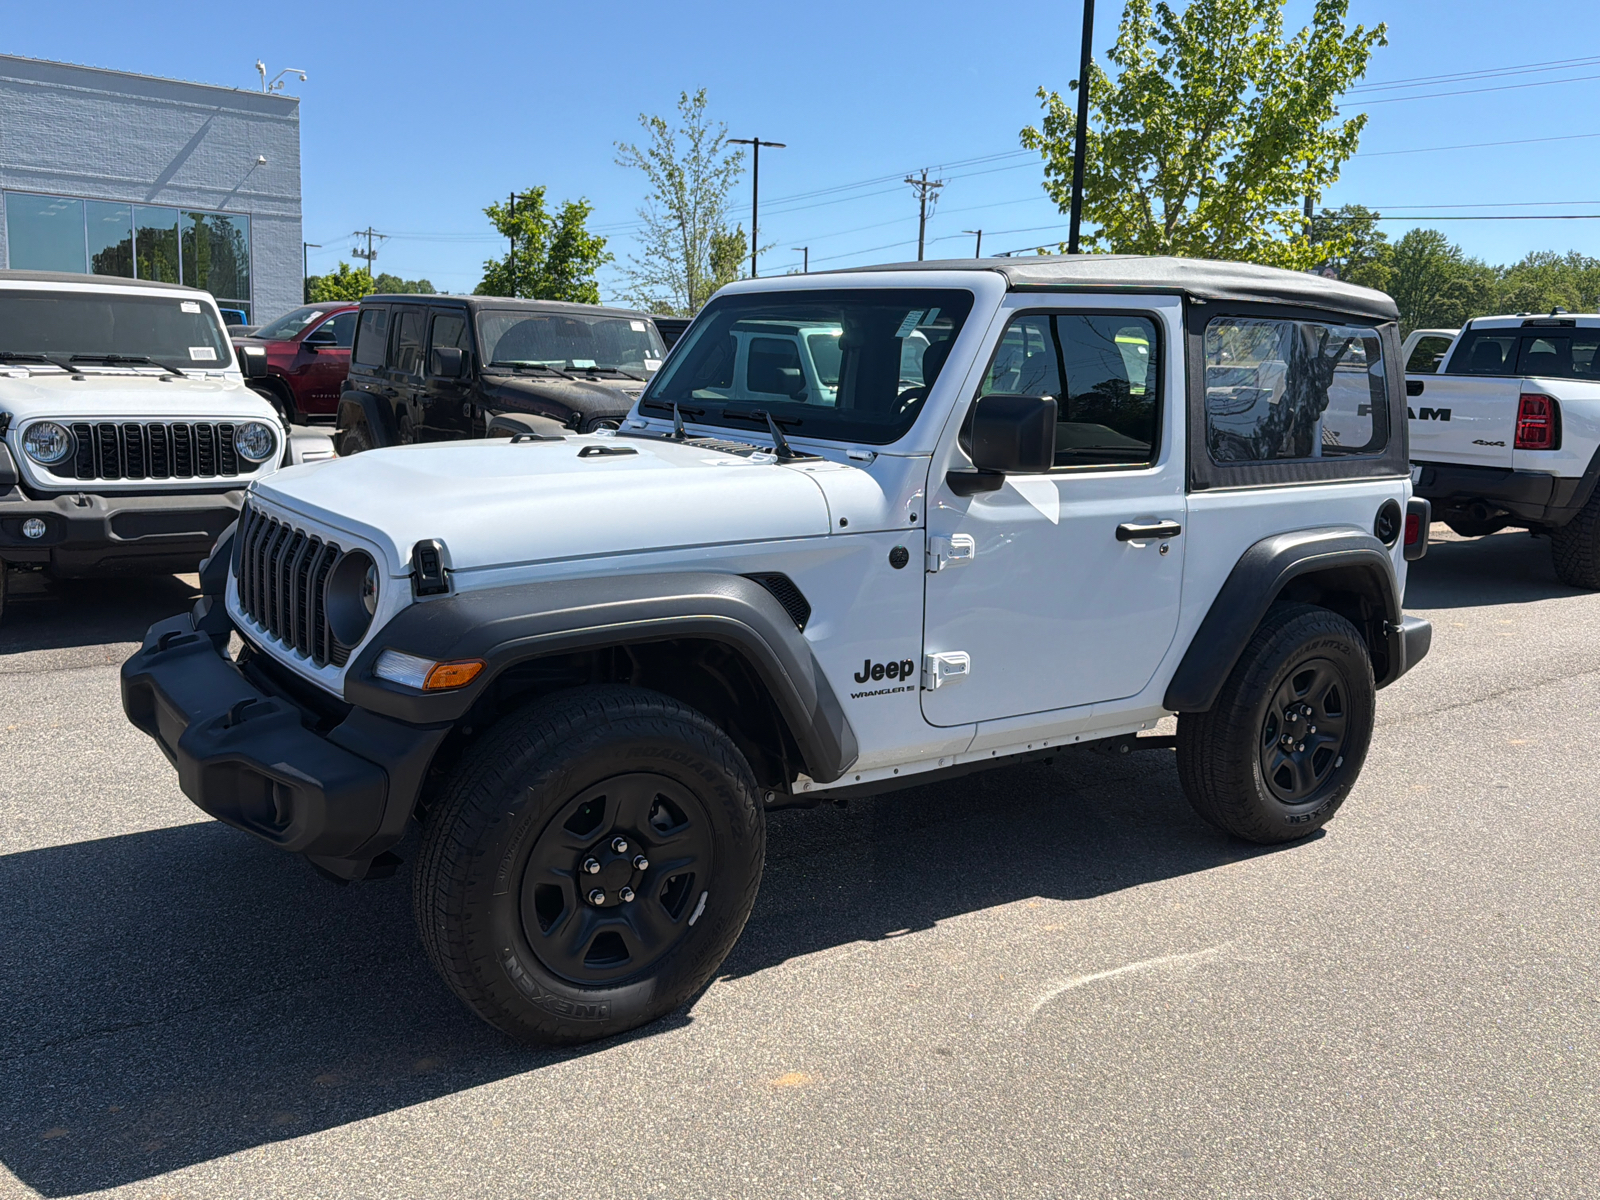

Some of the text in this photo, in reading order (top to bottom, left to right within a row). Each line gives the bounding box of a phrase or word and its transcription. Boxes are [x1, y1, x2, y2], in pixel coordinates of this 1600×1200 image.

[1472, 439, 1506, 447] 4x4
[854, 658, 914, 684] Jeep
[850, 686, 905, 699] WRANGLER
[625, 746, 717, 782] ROADIAN
[1290, 793, 1339, 824] NEXEN
[503, 954, 597, 1019] NEXEN
